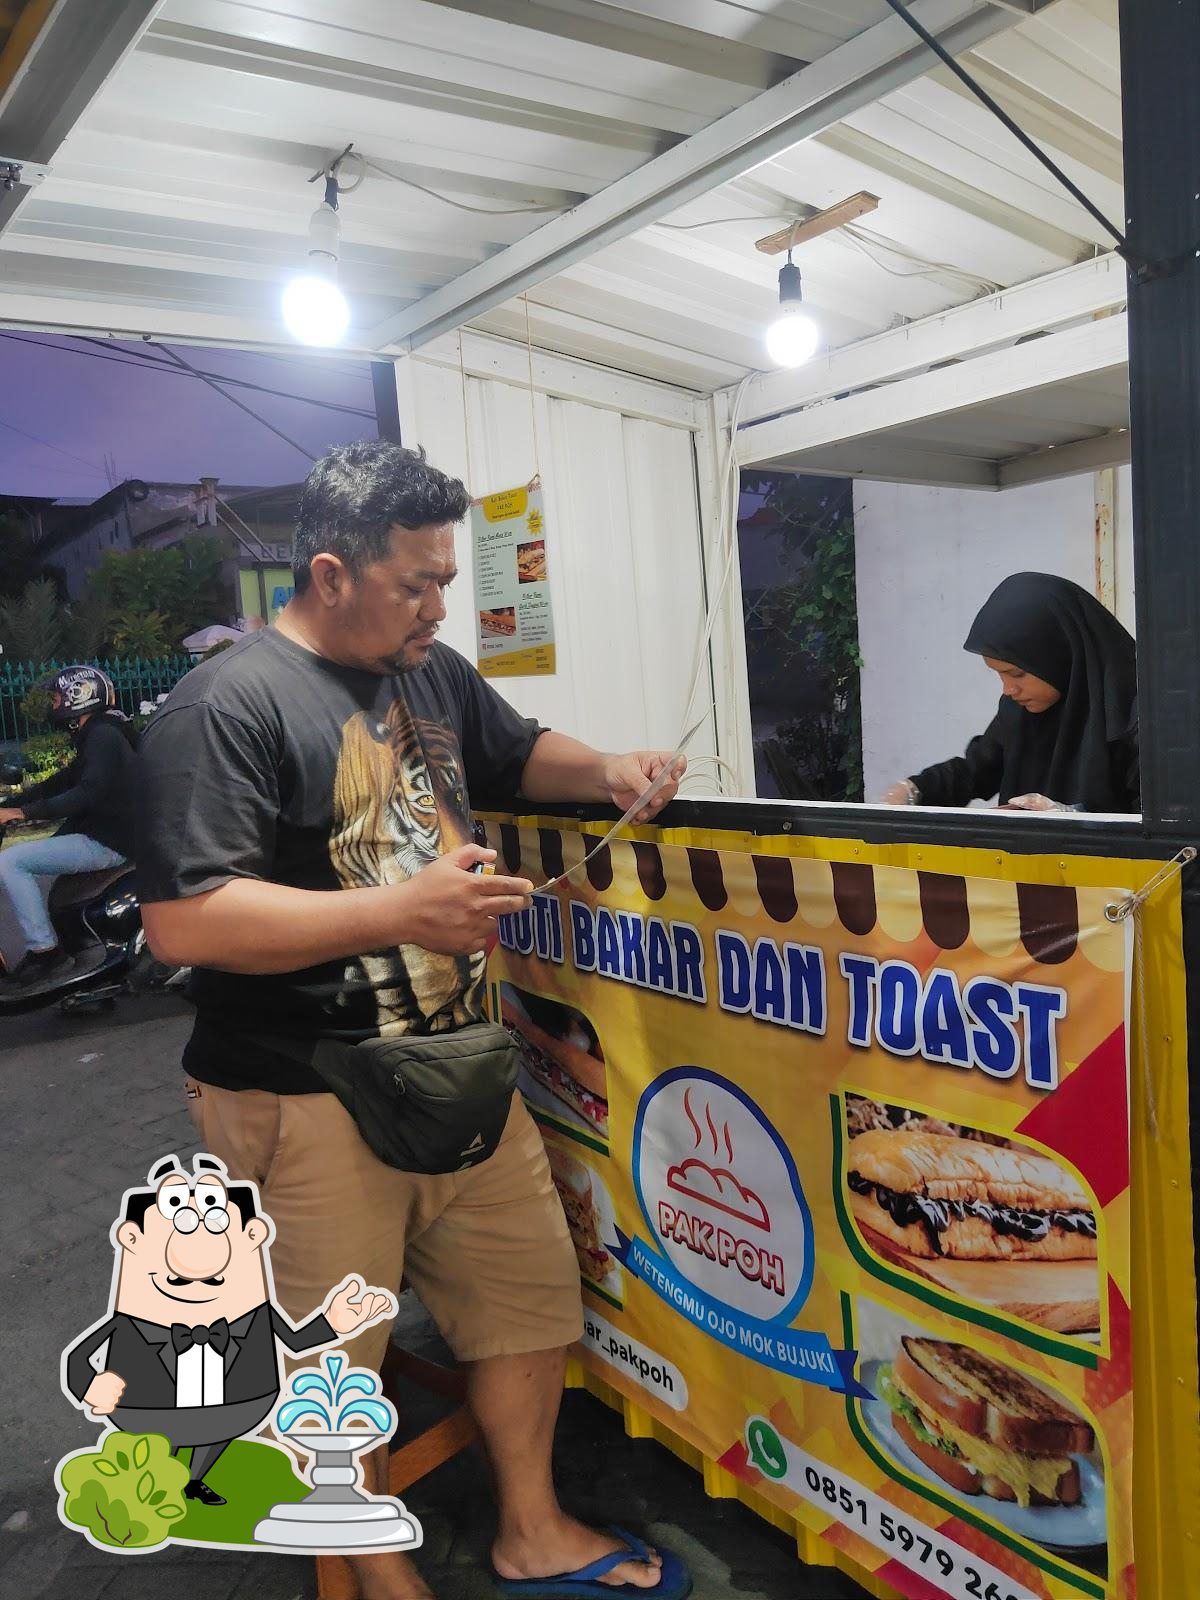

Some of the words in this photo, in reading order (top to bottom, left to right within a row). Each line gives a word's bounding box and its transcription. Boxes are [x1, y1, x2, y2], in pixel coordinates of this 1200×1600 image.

[569, 899, 706, 1003] BAKAR
[715, 929, 827, 1036] DAN
[840, 951, 1068, 1091] TOAST
[633, 1245, 705, 1321] WETENGMU
[707, 1312, 737, 1340] OJO
[739, 1326, 776, 1359] MOK
[776, 1340, 835, 1374] BUJUKI
[658, 1200, 716, 1261] PAK
[717, 1228, 785, 1296] POH
[584, 1320, 674, 1392] ar_pakpoh
[804, 1466, 868, 1525] 0851
[880, 1512, 954, 1577] 5979
[964, 1566, 1019, 1600] 26
